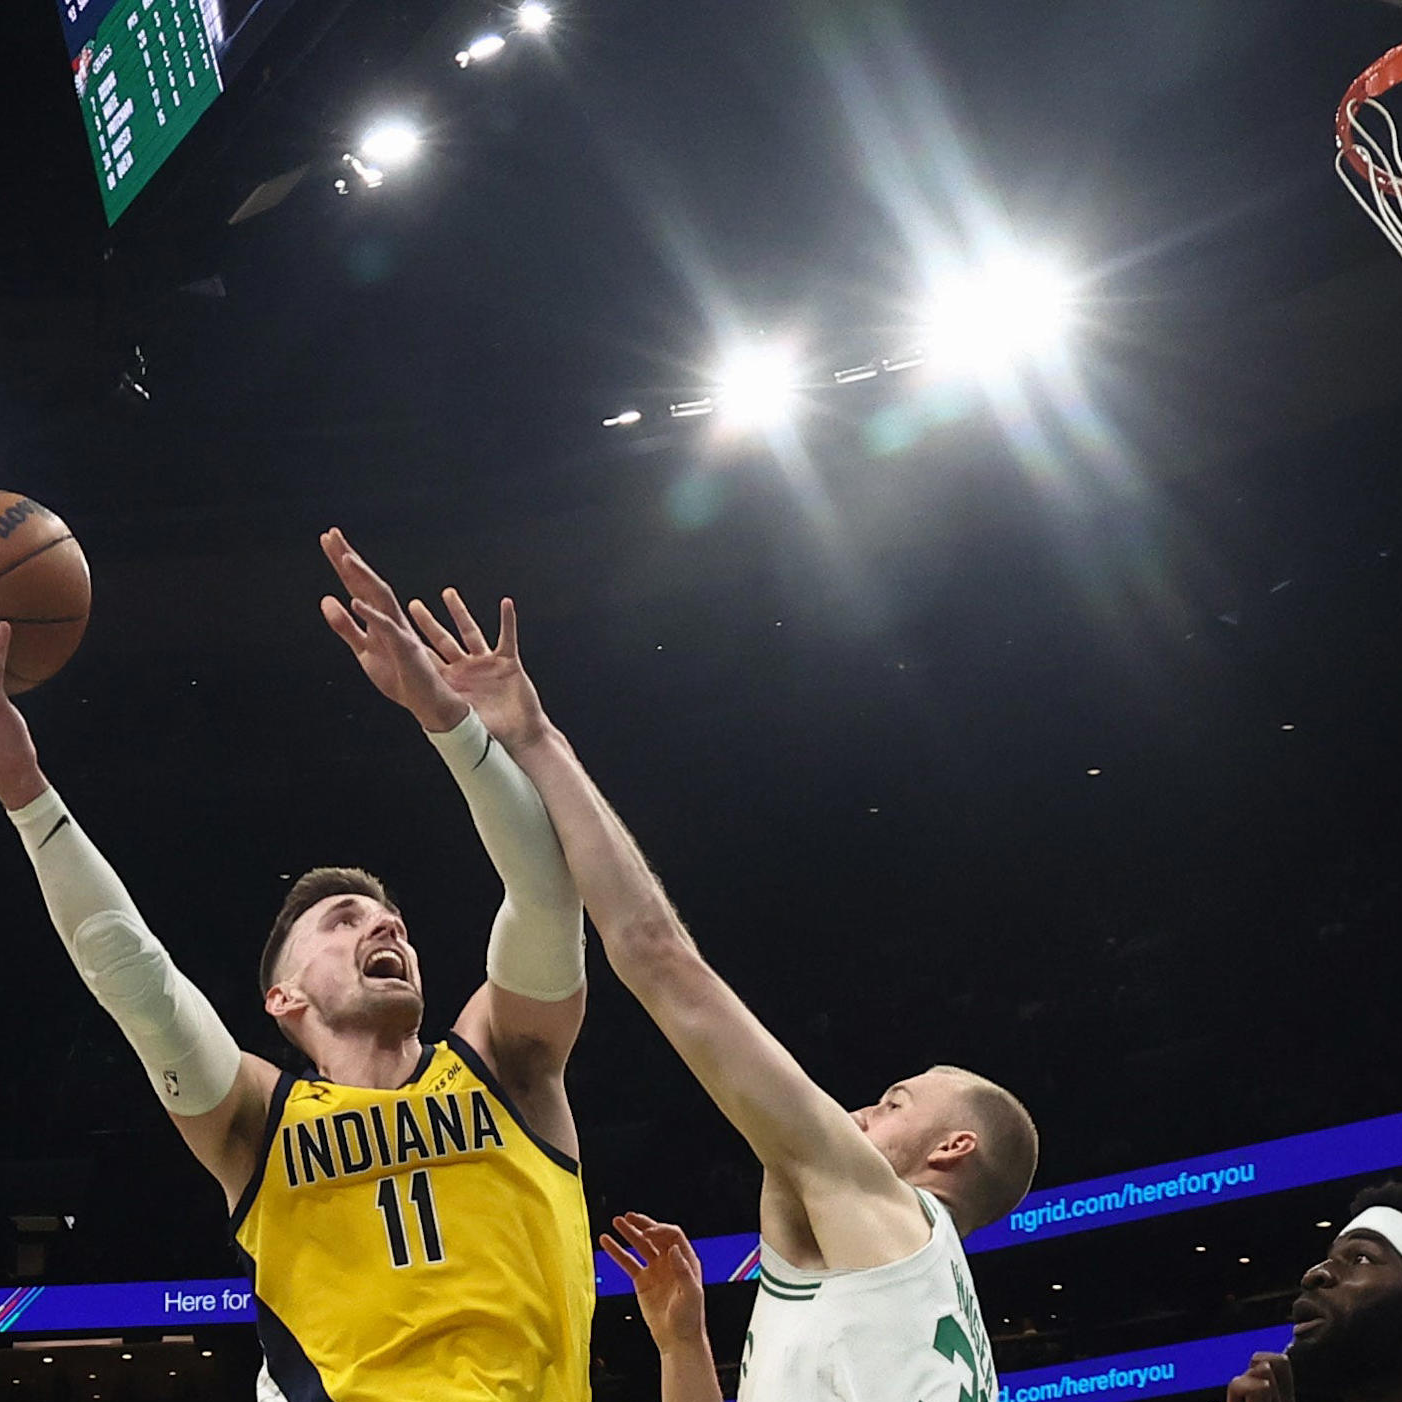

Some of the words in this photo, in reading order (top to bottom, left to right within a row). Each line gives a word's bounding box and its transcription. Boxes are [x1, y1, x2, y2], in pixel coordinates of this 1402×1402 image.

[282, 1088, 506, 1188] INDIANA
[374, 1168, 446, 1270] 11
[1010, 1163, 1255, 1232] ngrid.com/hereforyou
[164, 1291, 216, 1314] Here
[219, 1289, 252, 1312] for
